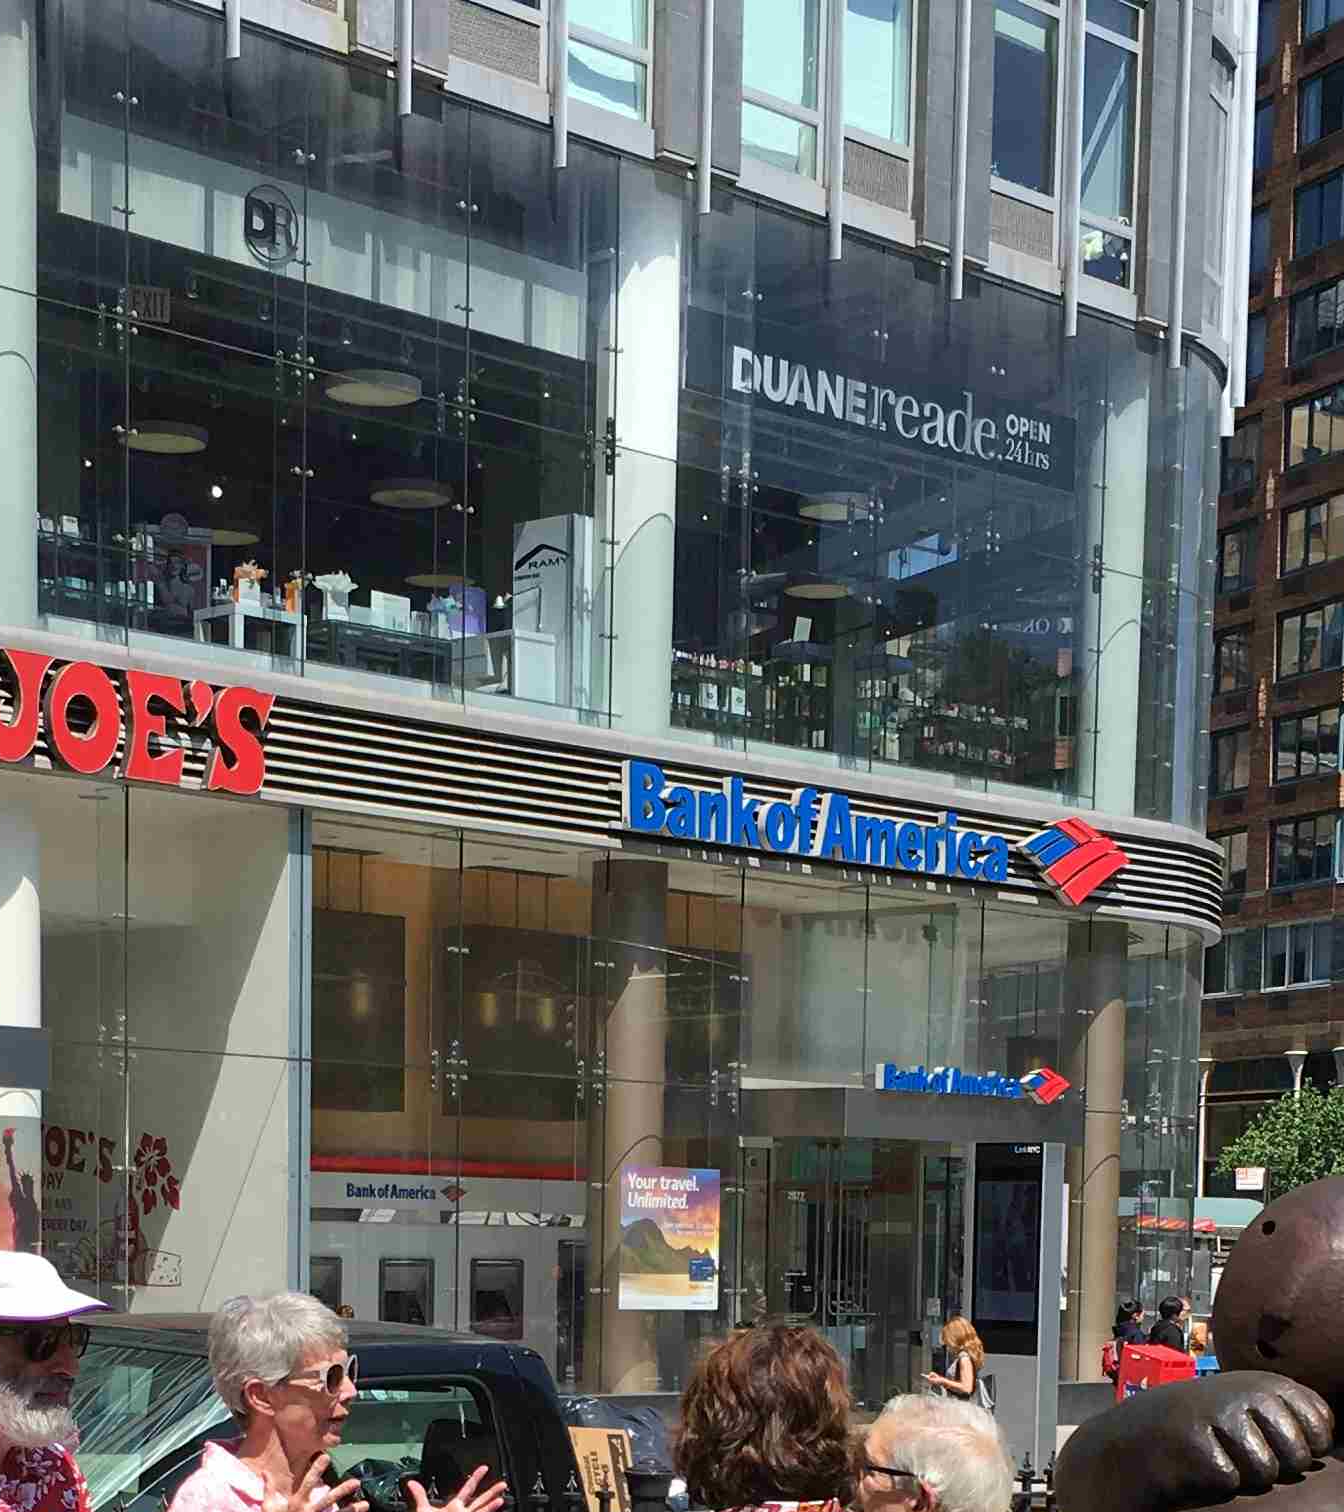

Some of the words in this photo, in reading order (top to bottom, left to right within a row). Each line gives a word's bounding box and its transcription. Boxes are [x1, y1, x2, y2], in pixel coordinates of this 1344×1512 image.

[732, 345, 866, 426] DUANE
[1006, 413, 1051, 445] OPEN
[1005, 437, 1051, 471] 24hrs
[621, 758, 758, 848] Bank
[759, 787, 816, 856] of
[815, 792, 1009, 882] America
[41, 1124, 118, 1184] OE'S
[346, 1182, 376, 1198] Bank
[376, 1183, 390, 1199] of
[390, 1183, 436, 1200] America
[627, 1172, 659, 1189] Your
[660, 1175, 700, 1192] travel.
[627, 1192, 689, 1209] Unlimited.
